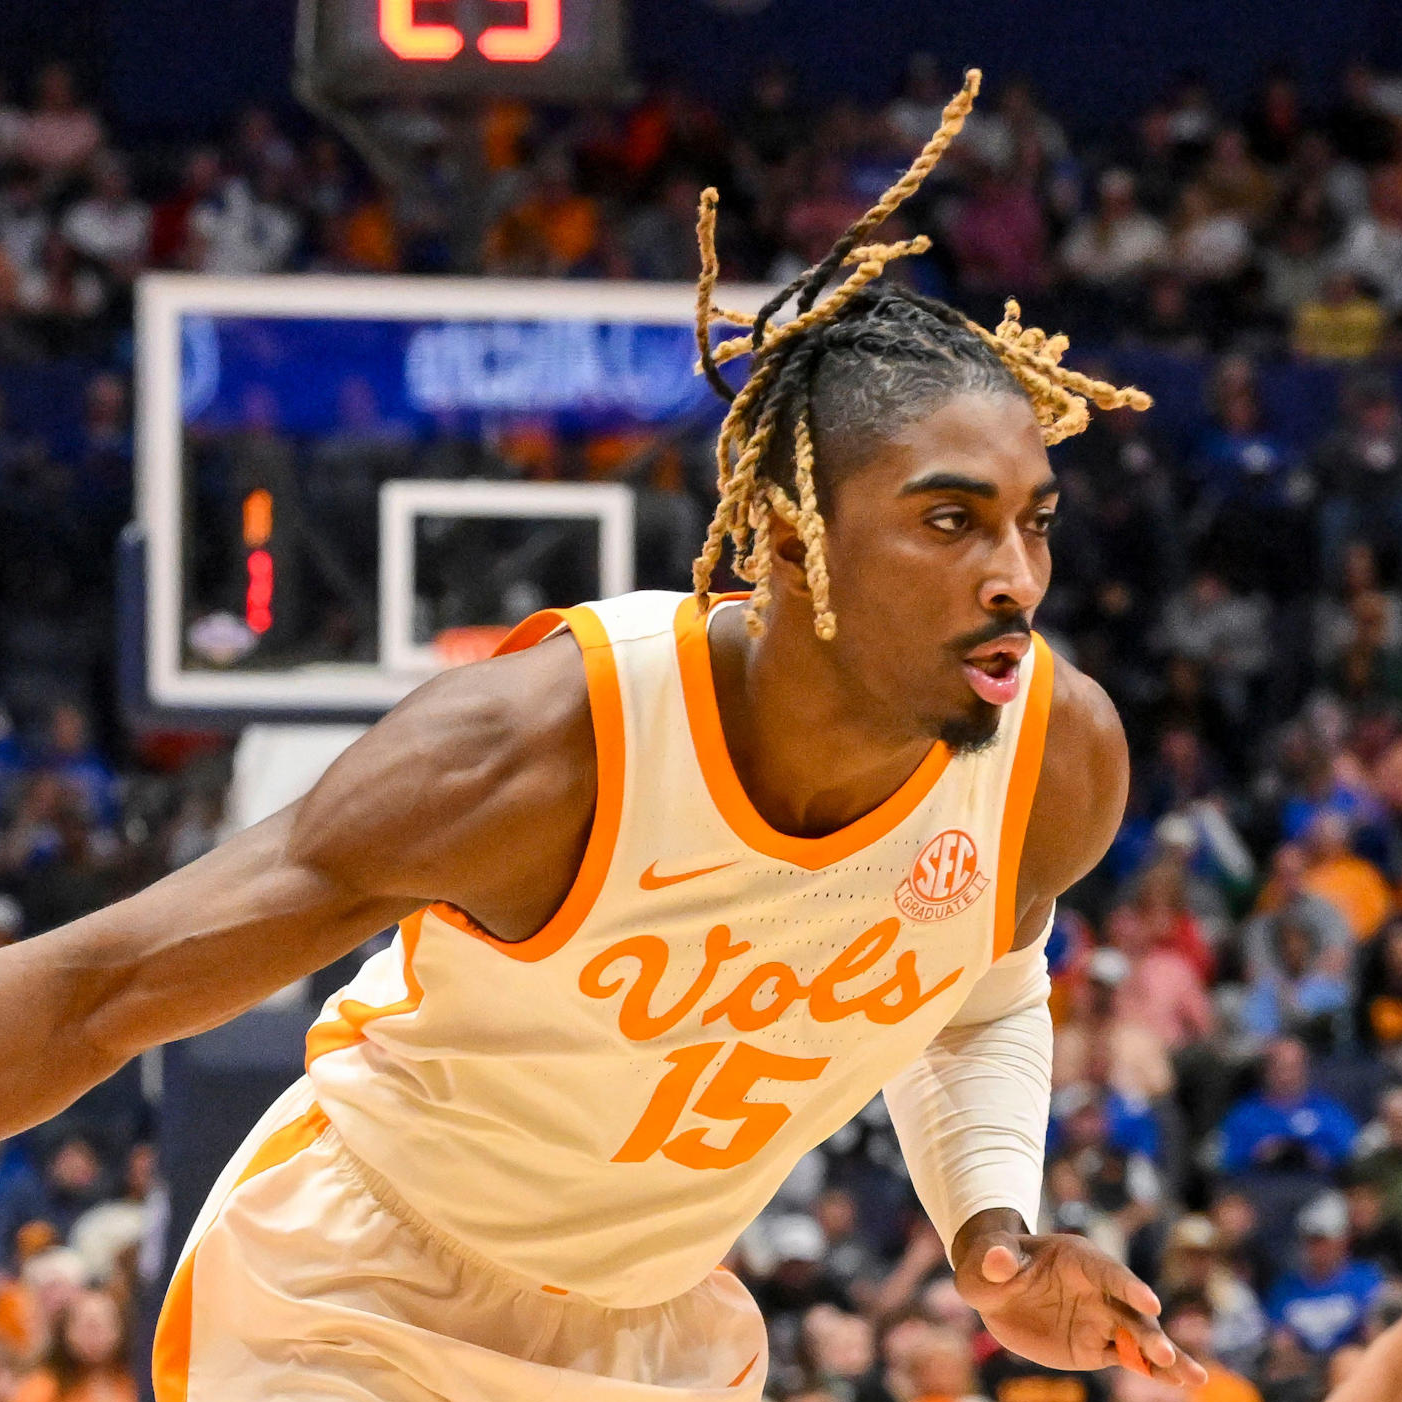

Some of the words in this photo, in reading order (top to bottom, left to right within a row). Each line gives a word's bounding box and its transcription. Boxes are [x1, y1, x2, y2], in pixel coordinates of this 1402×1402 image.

[901, 889, 974, 920] GRADUATE
[916, 831, 975, 899] SEC
[578, 917, 965, 1041] Vols
[609, 1041, 831, 1170] 15
